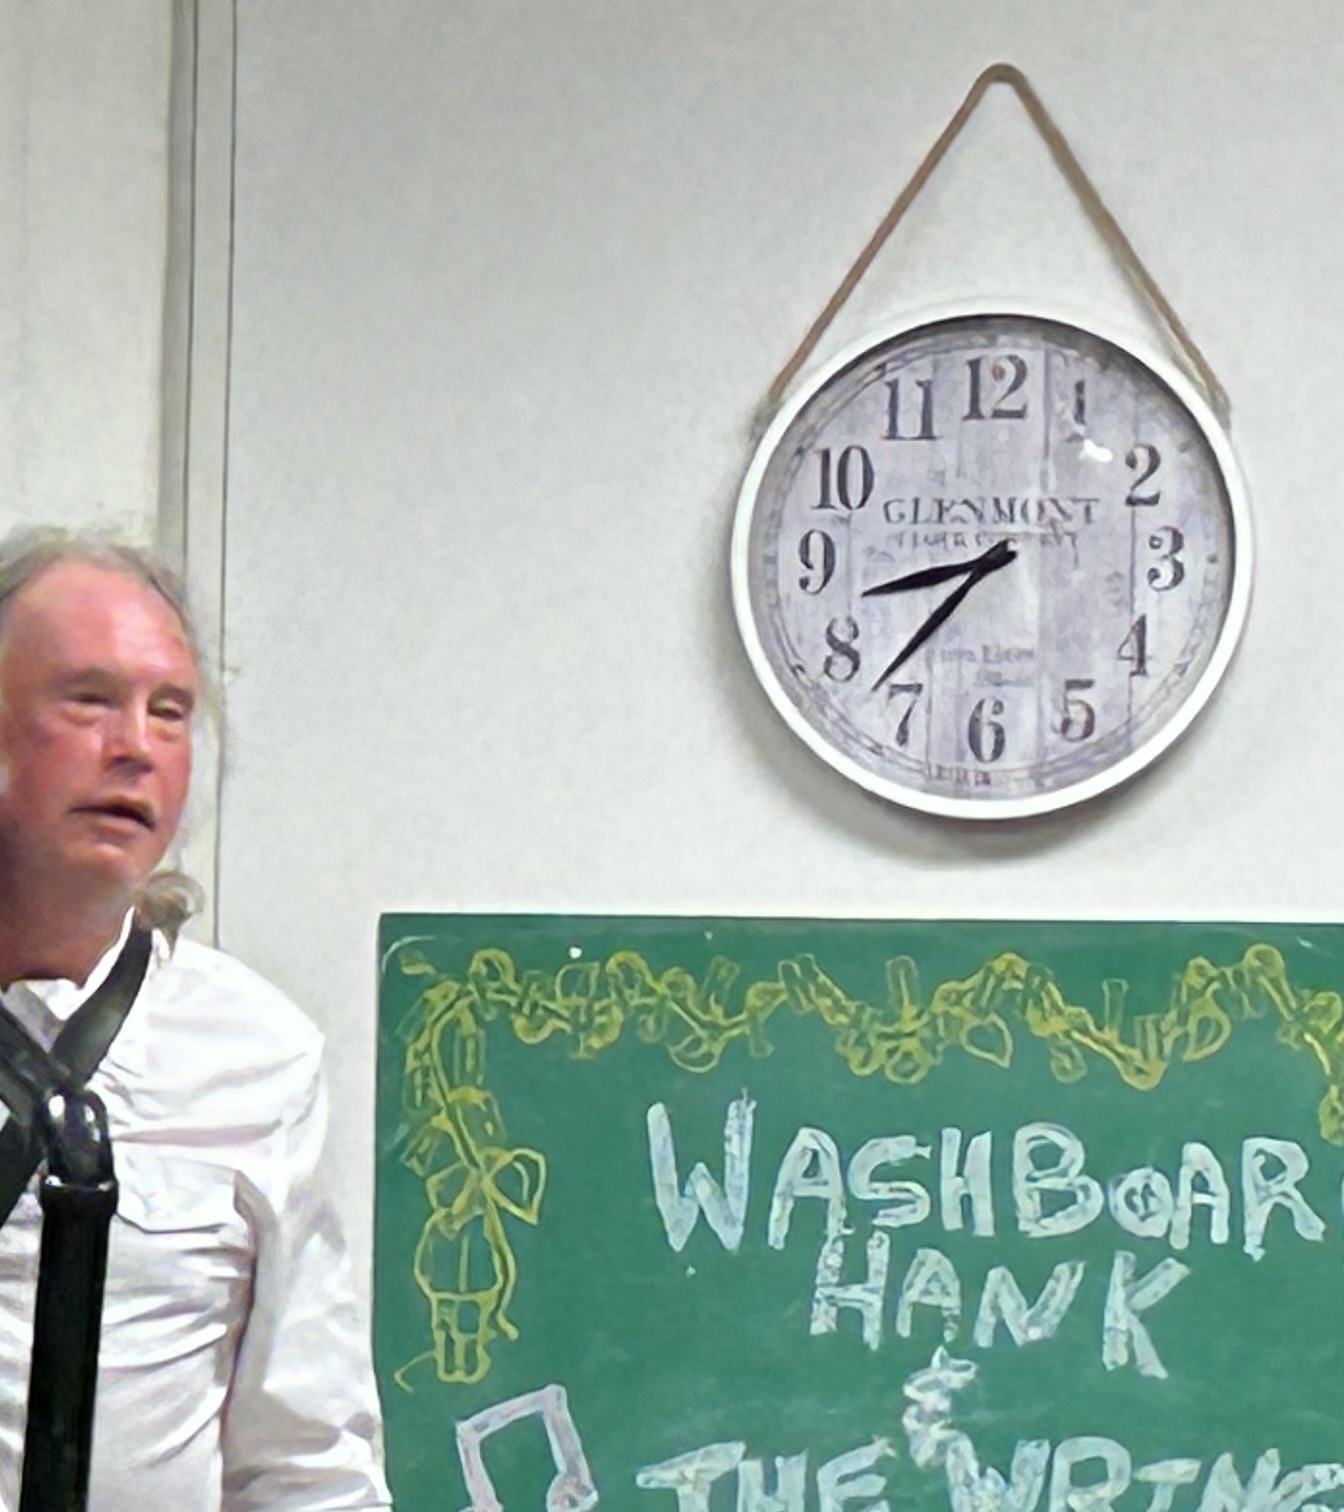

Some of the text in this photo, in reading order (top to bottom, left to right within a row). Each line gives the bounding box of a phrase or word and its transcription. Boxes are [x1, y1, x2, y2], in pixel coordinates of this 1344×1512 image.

[882, 378, 940, 441] 11
[963, 354, 1029, 420] 12
[1065, 379, 1088, 441] 1
[812, 444, 875, 511] 10
[1124, 443, 1162, 507] 2
[882, 497, 1101, 526] GLENMONT
[798, 528, 836, 595] 9
[1146, 525, 1185, 592] 3
[823, 615, 861, 683] 8
[1116, 613, 1150, 678] 4
[887, 682, 924, 748] 7
[968, 697, 1006, 763] 6
[1058, 678, 1097, 742] 5
[647, 1094, 1344, 1261] WASHBOAR
[809, 1231, 1192, 1379] HANK
